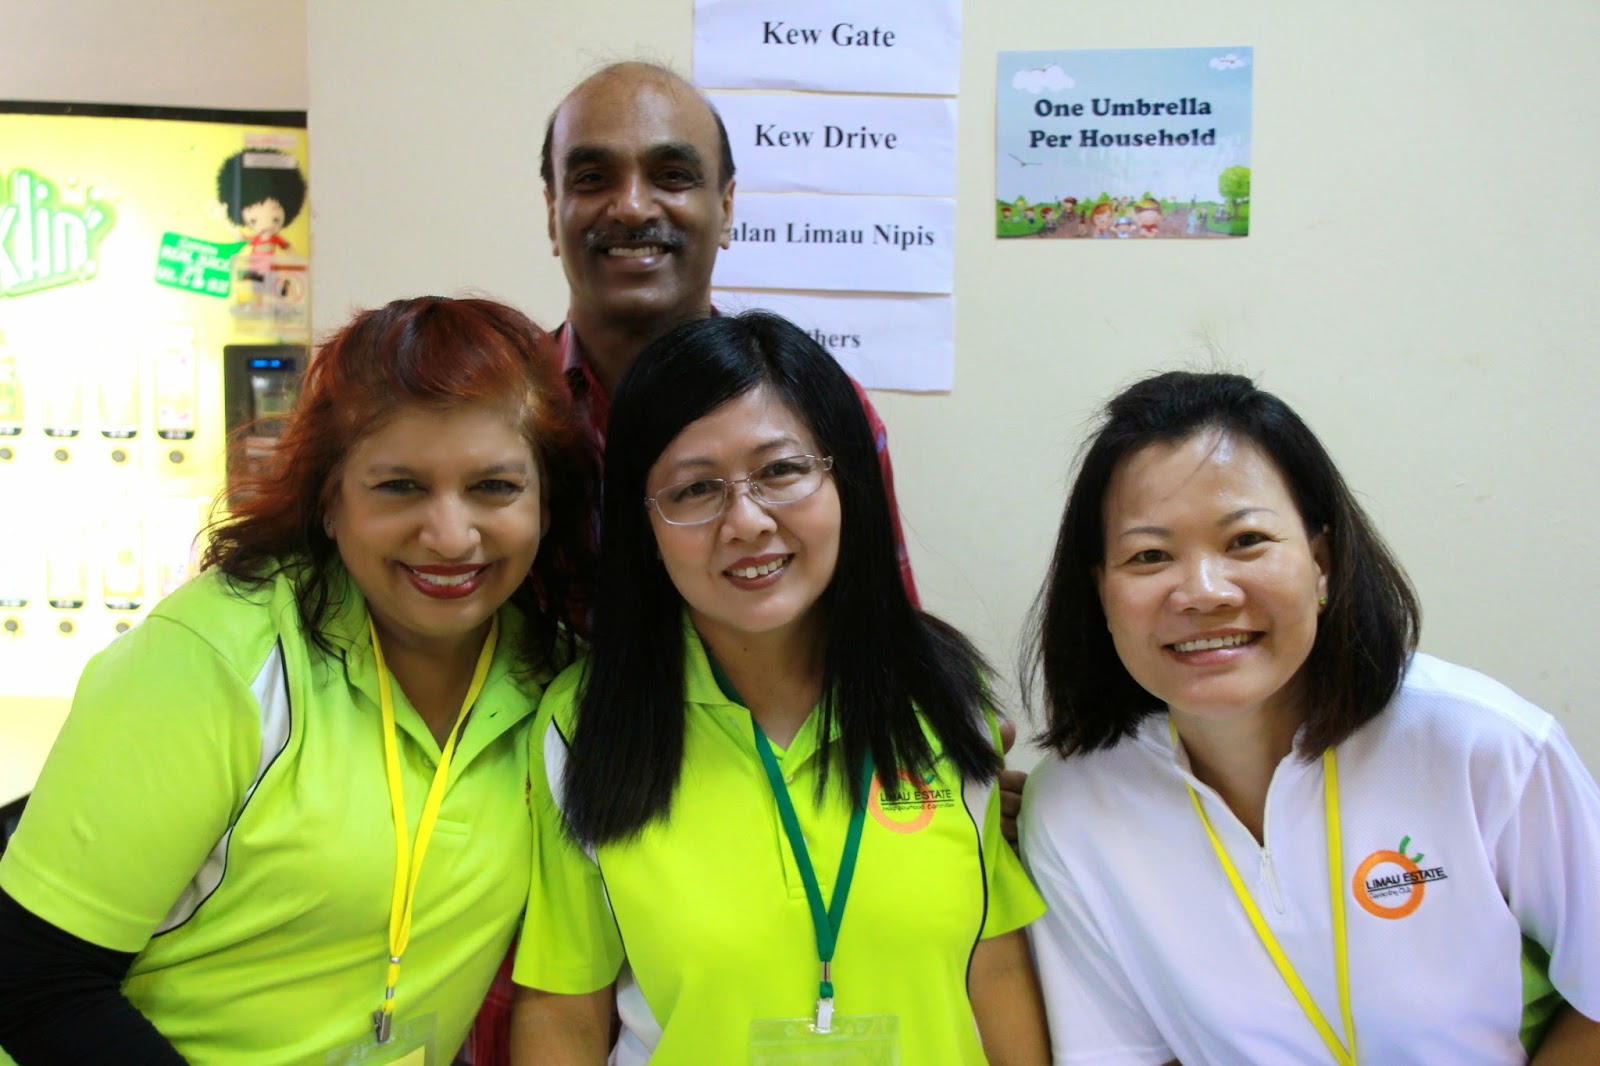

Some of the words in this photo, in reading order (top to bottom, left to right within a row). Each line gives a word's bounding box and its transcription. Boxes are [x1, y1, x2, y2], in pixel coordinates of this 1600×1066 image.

[762, 21, 822, 46] Kew
[832, 22, 896, 48] Gate
[1034, 99, 1083, 117] One
[1092, 97, 1211, 116] Umbrella
[755, 124, 814, 148] Kew
[823, 125, 897, 150] Drive
[1030, 130, 1072, 148] Per
[1079, 128, 1216, 147] Household
[730, 222, 776, 243] alan
[786, 223, 863, 244] Limau
[873, 224, 935, 250] Nipis
[808, 328, 860, 348] hers
[915, 790, 951, 800] ESTATE
[1365, 875, 1400, 889] LIMAU
[1403, 867, 1444, 881] ESTATE
